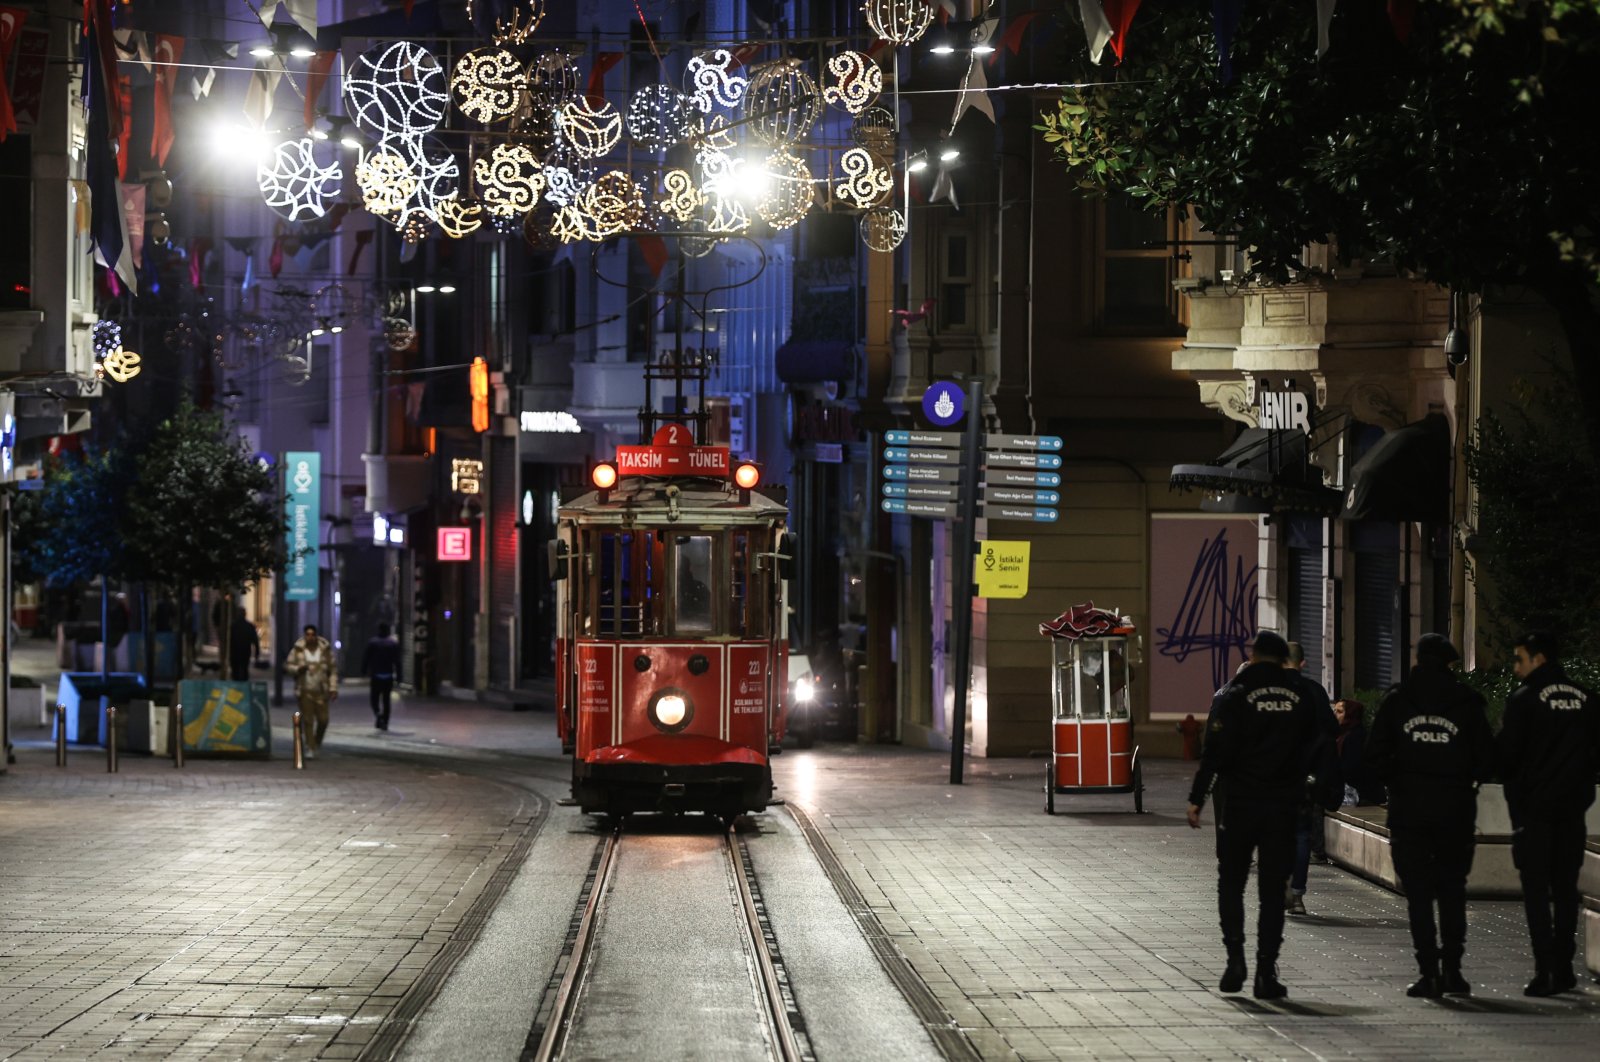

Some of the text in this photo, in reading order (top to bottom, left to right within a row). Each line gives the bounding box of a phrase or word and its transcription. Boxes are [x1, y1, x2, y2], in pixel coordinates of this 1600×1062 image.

[669, 426, 677, 444] 2
[620, 449, 662, 468] TAKSİM
[689, 449, 725, 468] TÜNEL
[446, 533, 465, 555] E
[999, 553, 1024, 563] İstiklal
[998, 563, 1020, 571] Senin
[585, 659, 597, 673] 223
